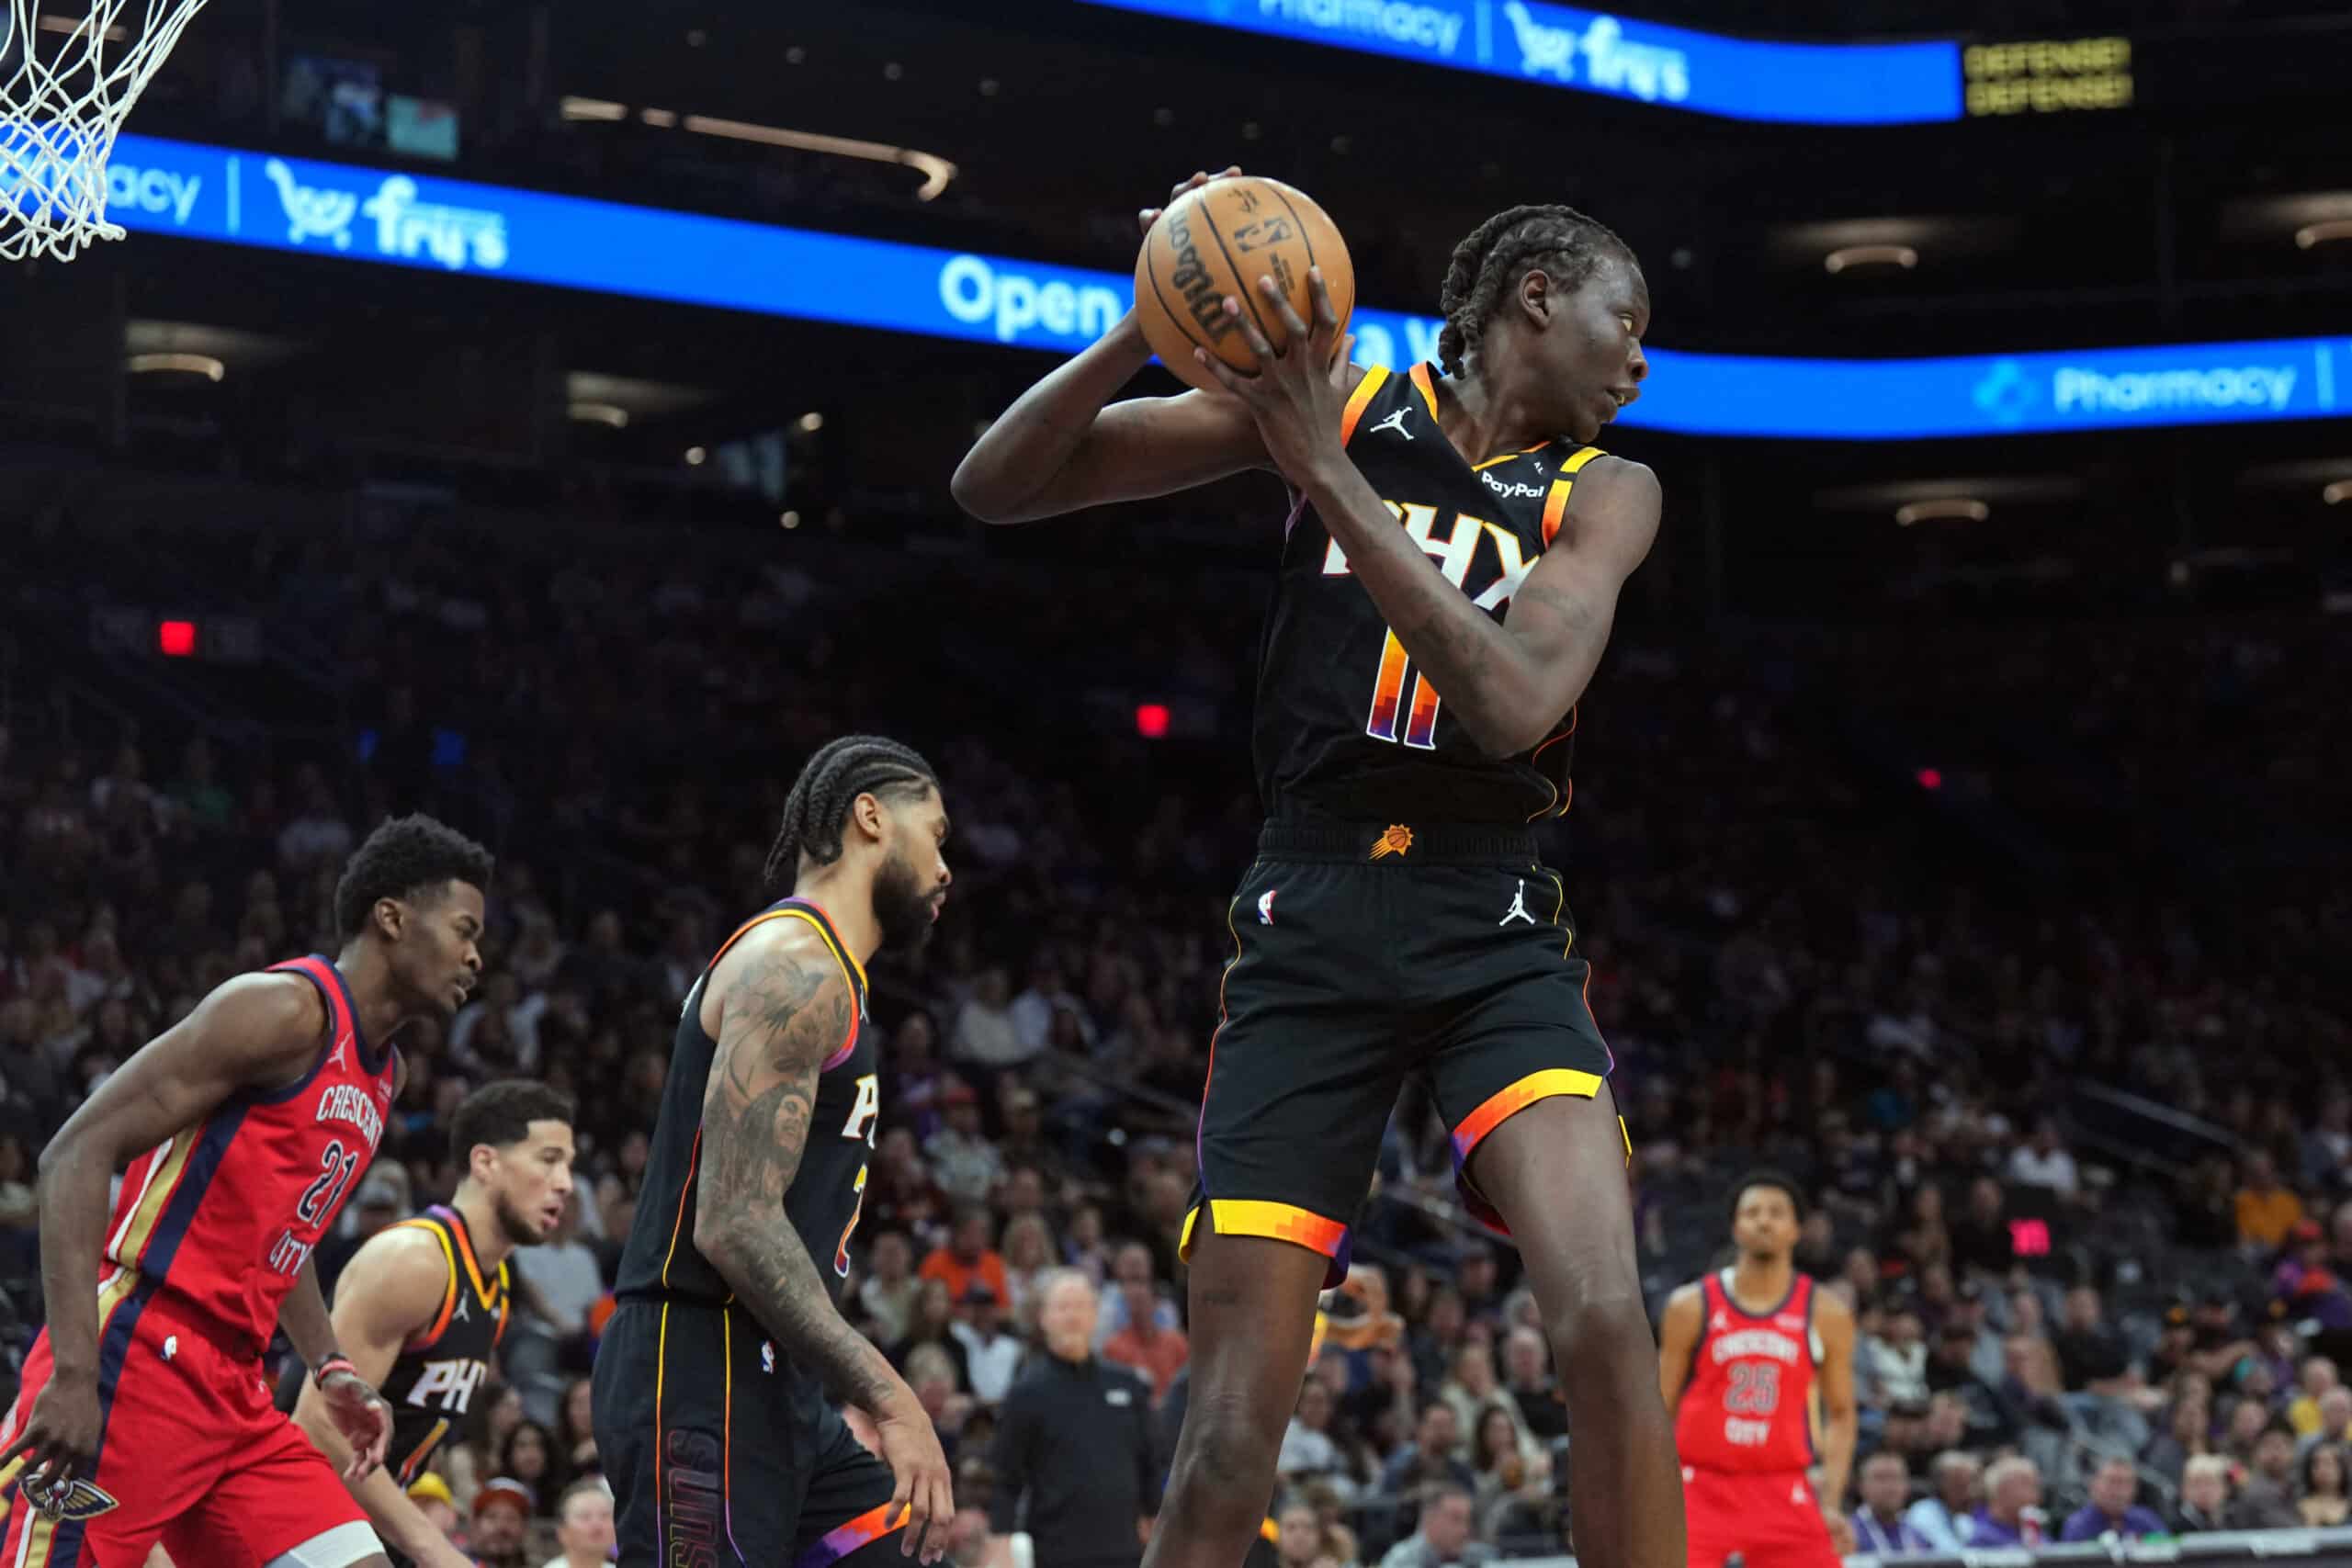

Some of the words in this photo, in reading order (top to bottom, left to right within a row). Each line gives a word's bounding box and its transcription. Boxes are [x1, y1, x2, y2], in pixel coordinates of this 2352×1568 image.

[938, 254, 1123, 343] Open
[2053, 366, 2296, 413] Pharmacy
[1481, 470, 1544, 498] PayPal
[1321, 500, 1541, 612] HX
[315, 1084, 384, 1157] CRESCENT
[297, 1138, 359, 1229] 21
[269, 1228, 314, 1277] CITY
[1724, 1360, 1781, 1416] 25
